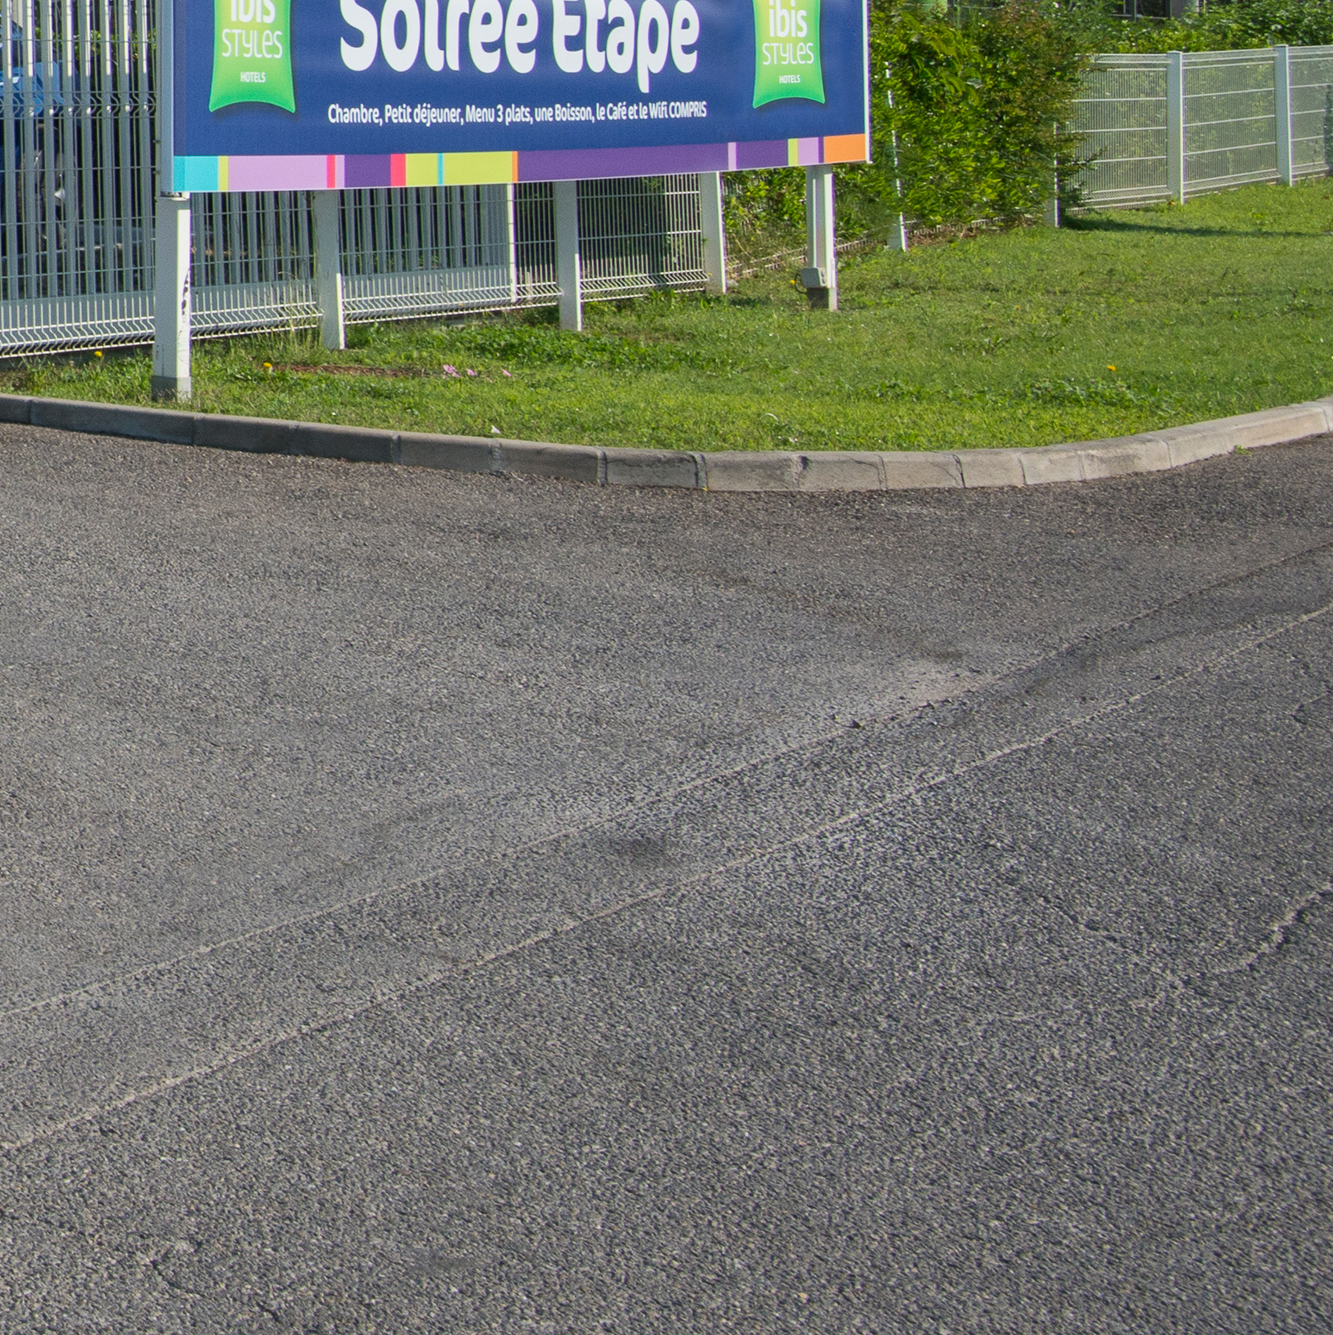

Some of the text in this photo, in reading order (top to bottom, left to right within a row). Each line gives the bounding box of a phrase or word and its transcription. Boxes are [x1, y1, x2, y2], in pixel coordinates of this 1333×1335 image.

[240, 71, 266, 83] HOTELS
[778, 74, 801, 84] HOTELS
[327, 100, 708, 127] Chambre, Petit déjeuner, Menu 3 plats, une Boisson, le Café et le Wifi COMPRIS
